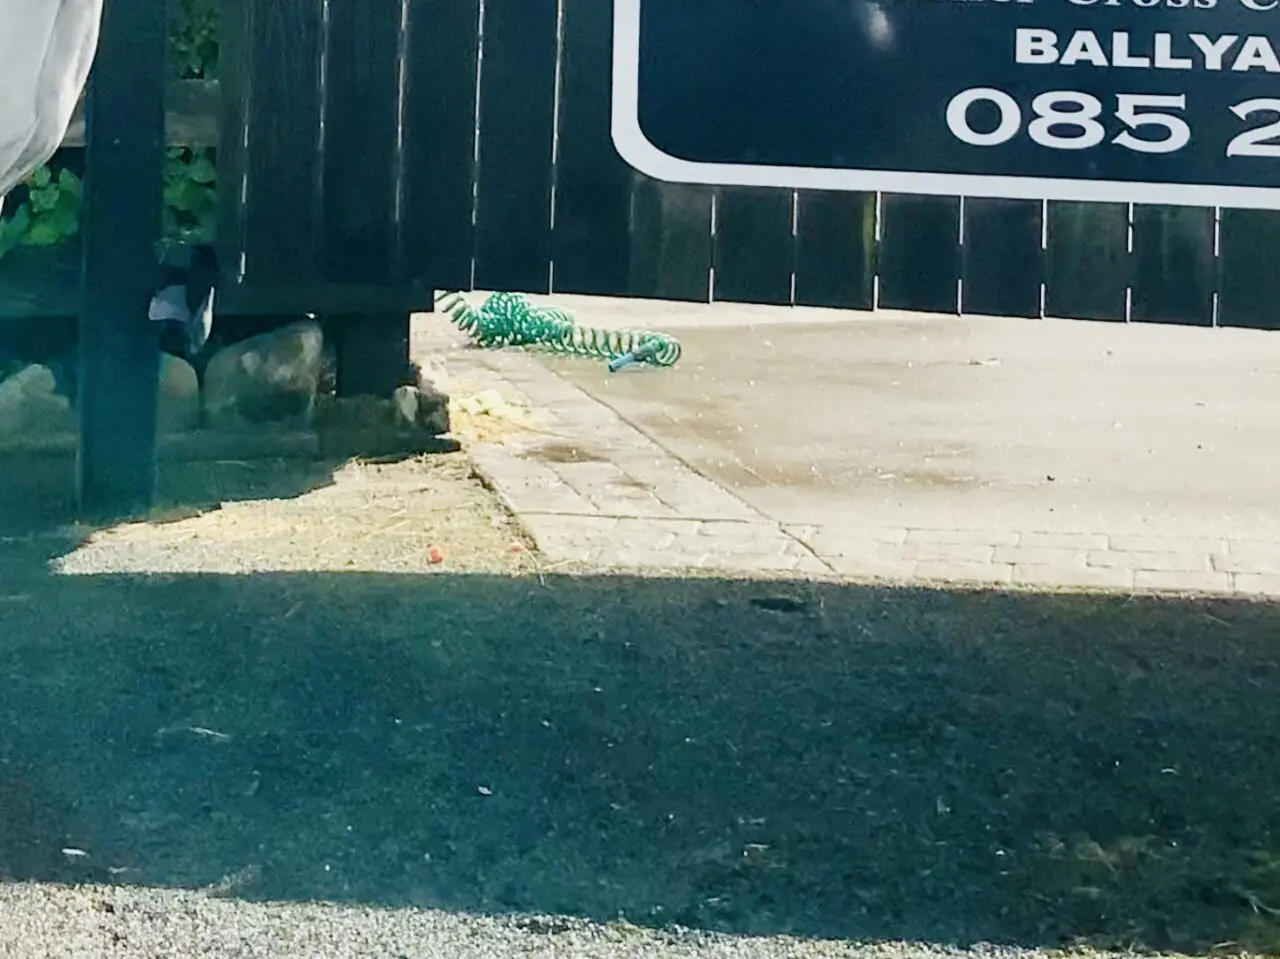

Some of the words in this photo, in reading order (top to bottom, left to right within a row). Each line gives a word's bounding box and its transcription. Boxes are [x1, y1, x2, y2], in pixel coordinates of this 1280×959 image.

[1015, 28, 1280, 72] BALLYA
[946, 87, 1191, 154] 085
[1226, 98, 1280, 158] 2
